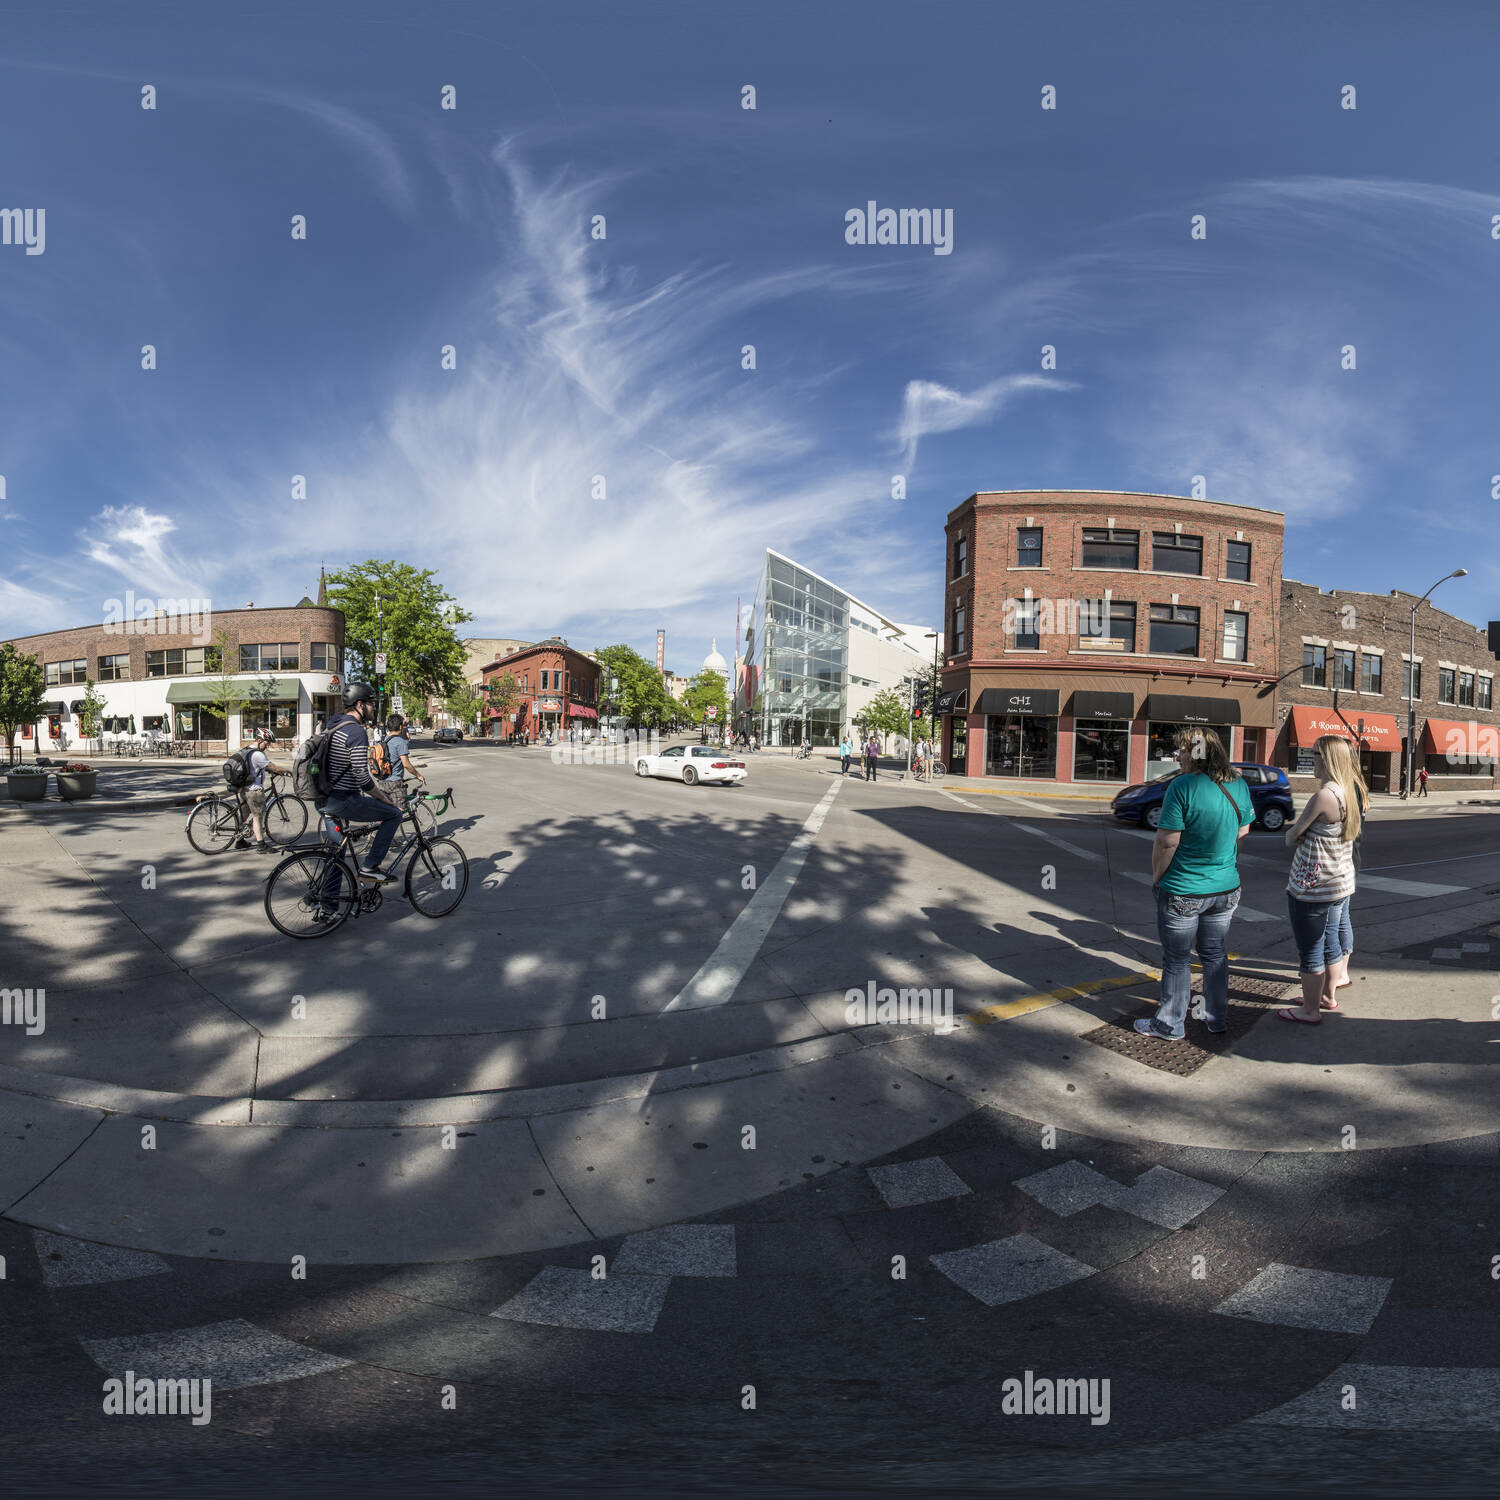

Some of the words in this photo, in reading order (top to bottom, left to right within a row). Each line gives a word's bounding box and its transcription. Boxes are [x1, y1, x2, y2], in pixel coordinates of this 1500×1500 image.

[1010, 696, 1031, 705] CHI
[1309, 720, 1316, 729] A
[1319, 721, 1341, 731] Room
[1342, 723, 1350, 734] of
[1371, 726, 1389, 734] Own
